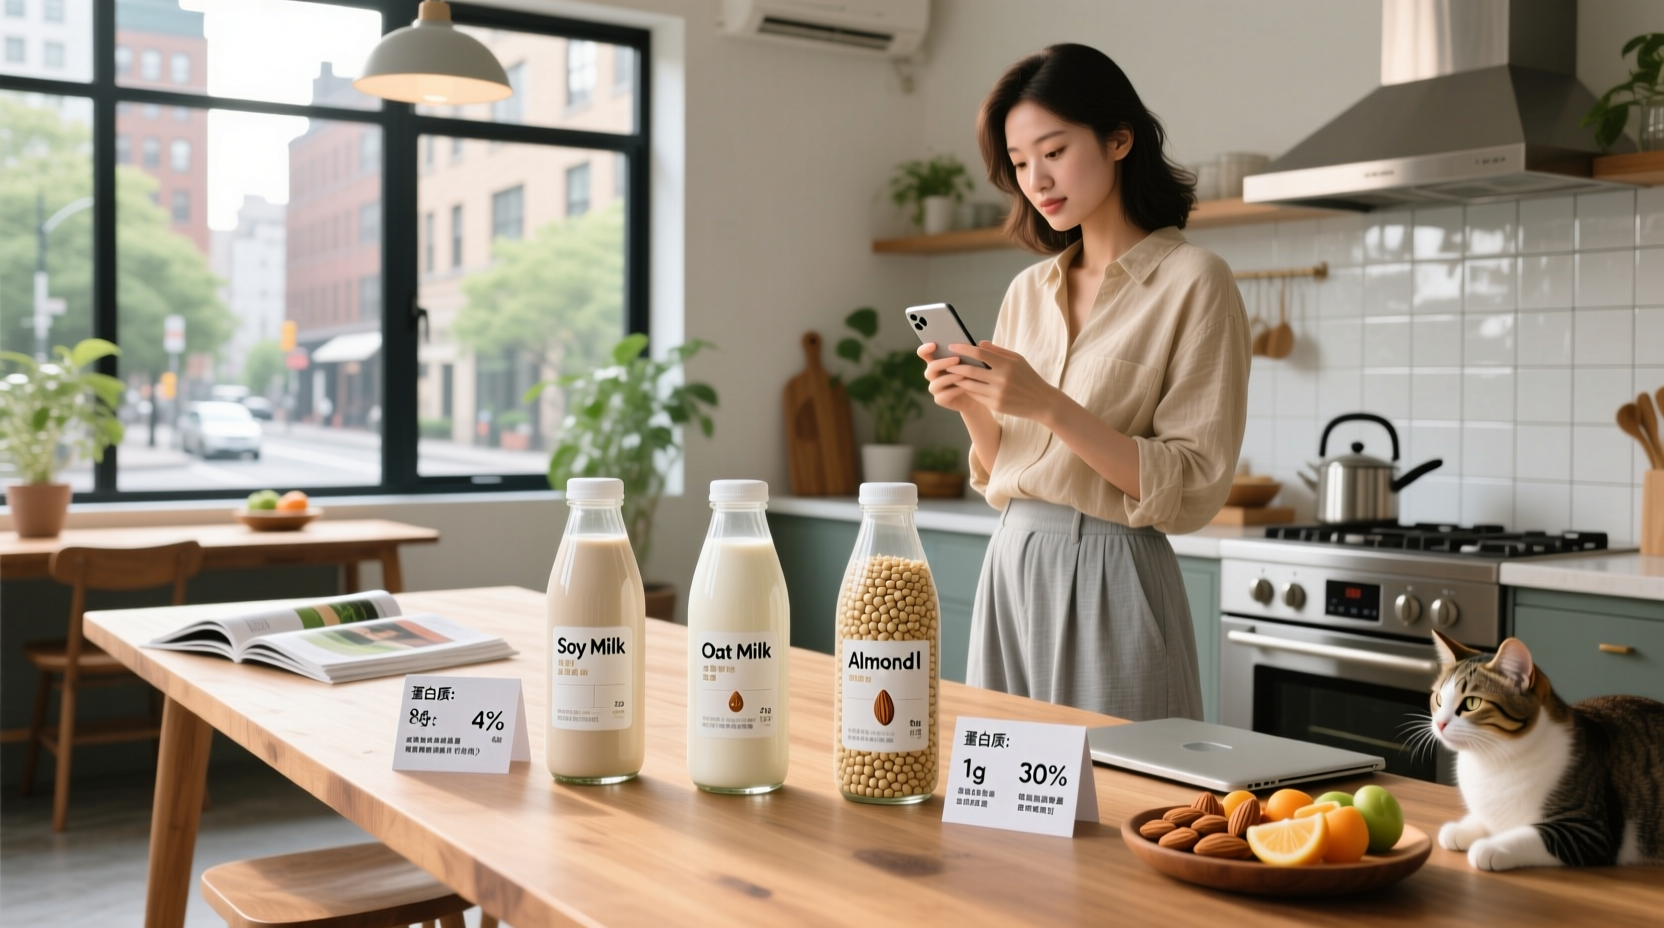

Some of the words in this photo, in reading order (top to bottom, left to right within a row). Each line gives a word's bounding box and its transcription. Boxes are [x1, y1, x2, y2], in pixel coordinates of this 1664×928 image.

[557, 637, 587, 660] Soy
[590, 637, 626, 655] Milk
[701, 642, 733, 660] Oat
[736, 641, 772, 660] Milk
[471, 710, 505, 731] 4%
[963, 758, 986, 785] 1g
[1018, 762, 1067, 787] 30%
